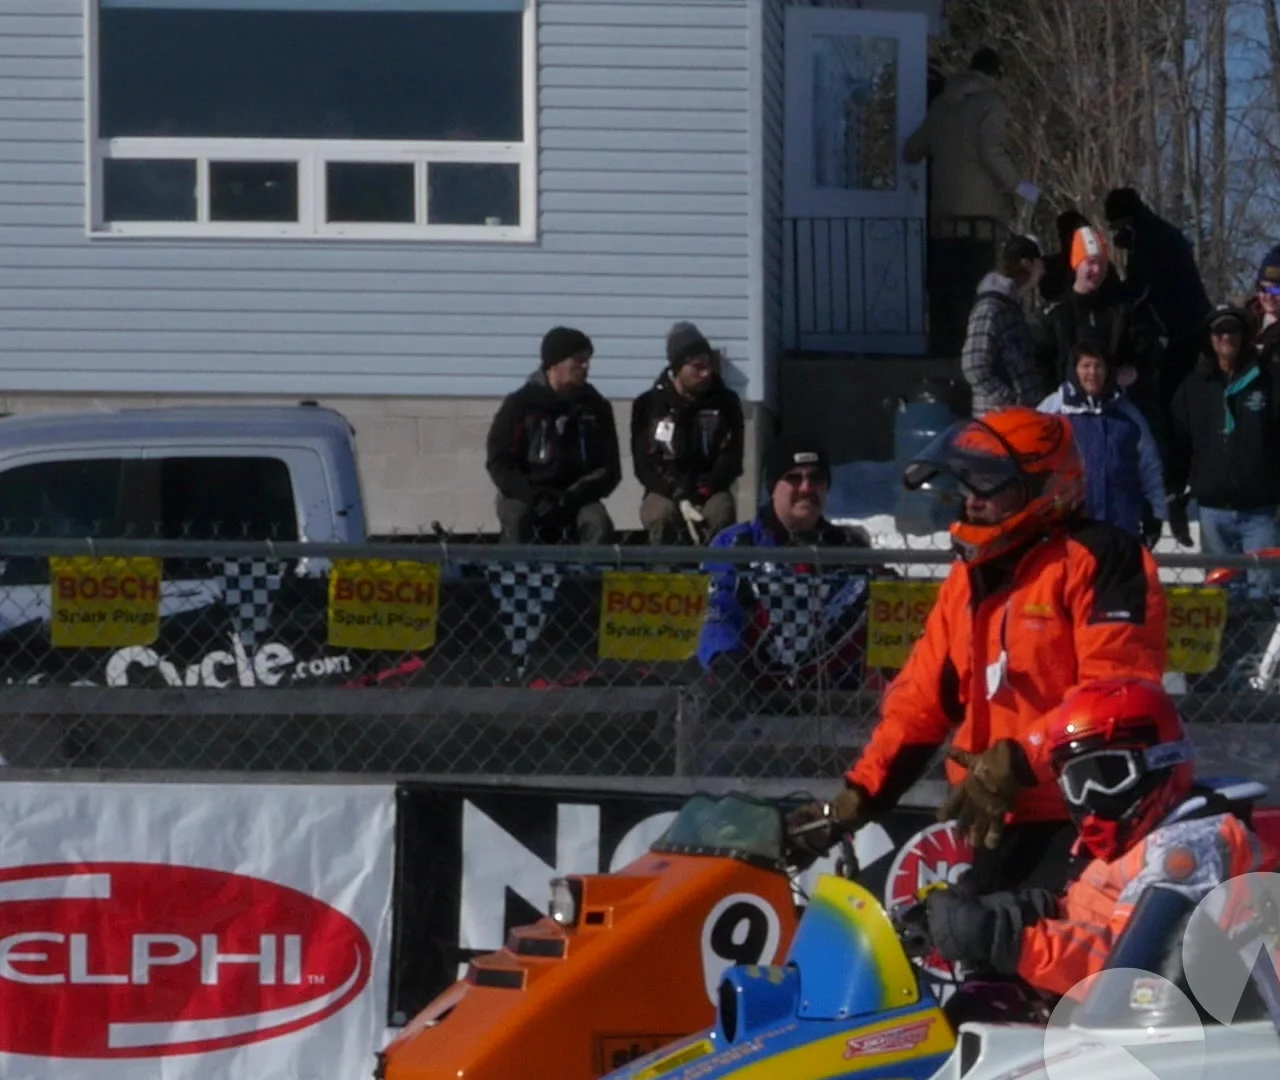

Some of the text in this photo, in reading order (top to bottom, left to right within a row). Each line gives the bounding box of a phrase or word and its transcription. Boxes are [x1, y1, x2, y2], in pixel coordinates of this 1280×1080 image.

[57, 576, 159, 601] BOSCH
[334, 578, 433, 606] BOSCH
[607, 590, 704, 616] BOSCH
[874, 601, 929, 623] BOS
[58, 608, 108, 624] Spark
[1168, 606, 1222, 631] SCH
[710, 902, 769, 965] 9
[0, 932, 302, 985] ELPHI
